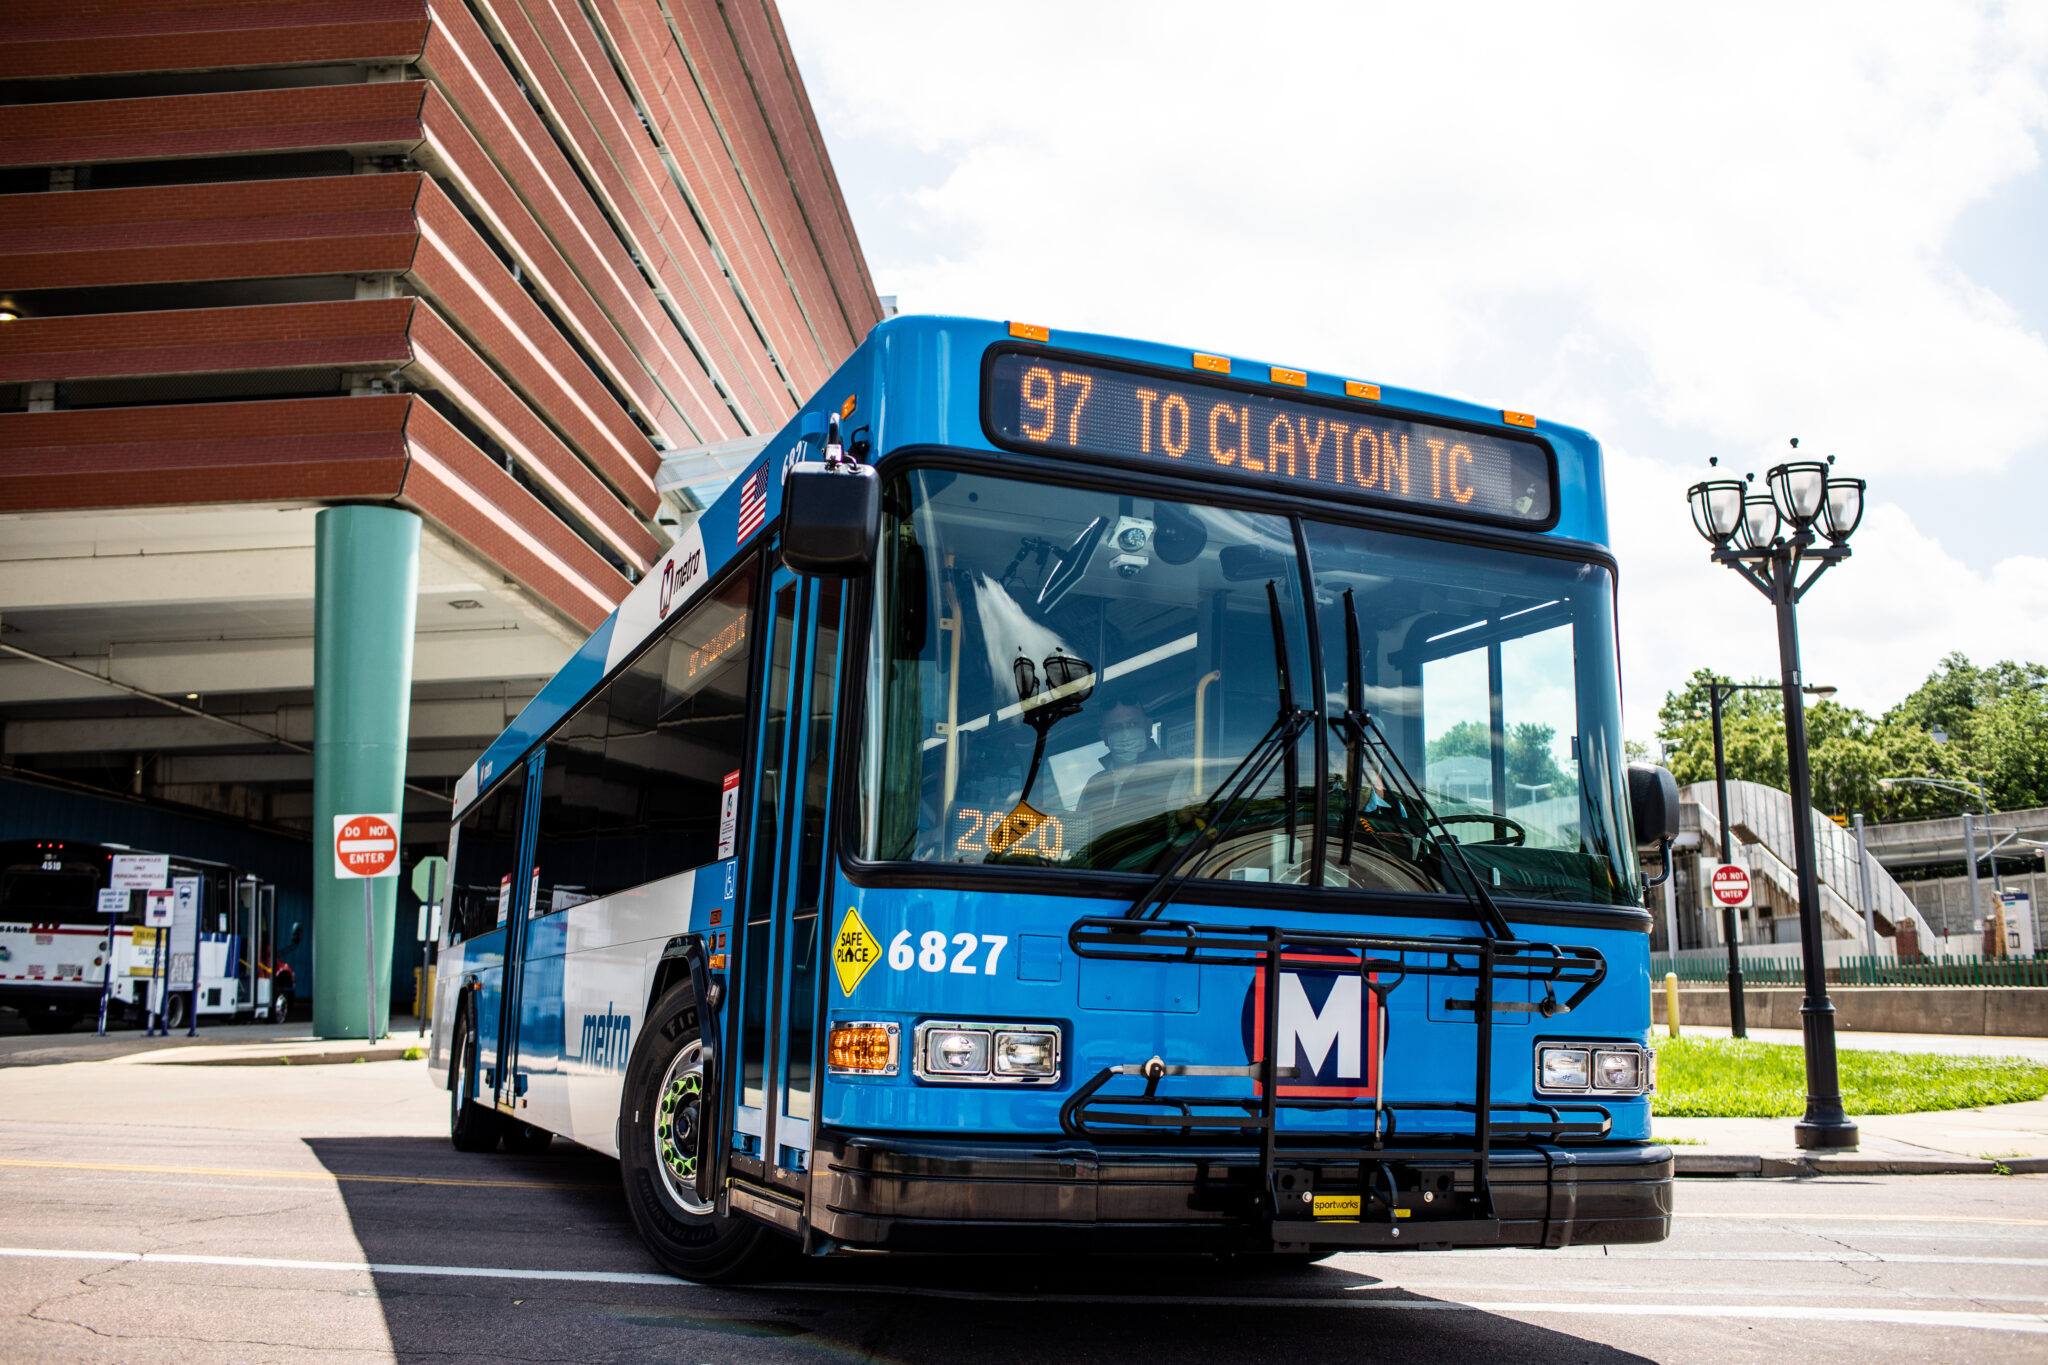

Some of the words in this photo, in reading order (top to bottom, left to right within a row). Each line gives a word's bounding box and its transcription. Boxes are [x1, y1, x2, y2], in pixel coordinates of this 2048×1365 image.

[1022, 366, 1092, 446] 97
[1136, 388, 1190, 458] TO
[1209, 402, 1409, 496] CLAYTON
[1426, 438, 1475, 504] TC
[673, 548, 701, 596] metro
[344, 826, 361, 838] DO
[368, 825, 388, 837] NOT
[957, 808, 1063, 857] 2020
[349, 852, 385, 864] ENTER
[1716, 872, 1728, 881] DO
[1729, 872, 1744, 880] NOT
[1720, 890, 1743, 899] ENTER
[841, 932, 863, 947] SAFE
[887, 929, 1008, 976] 6827
[581, 1001, 631, 1076] metro
[1277, 972, 1362, 1079] M
[1314, 1200, 1359, 1211] sportworks
